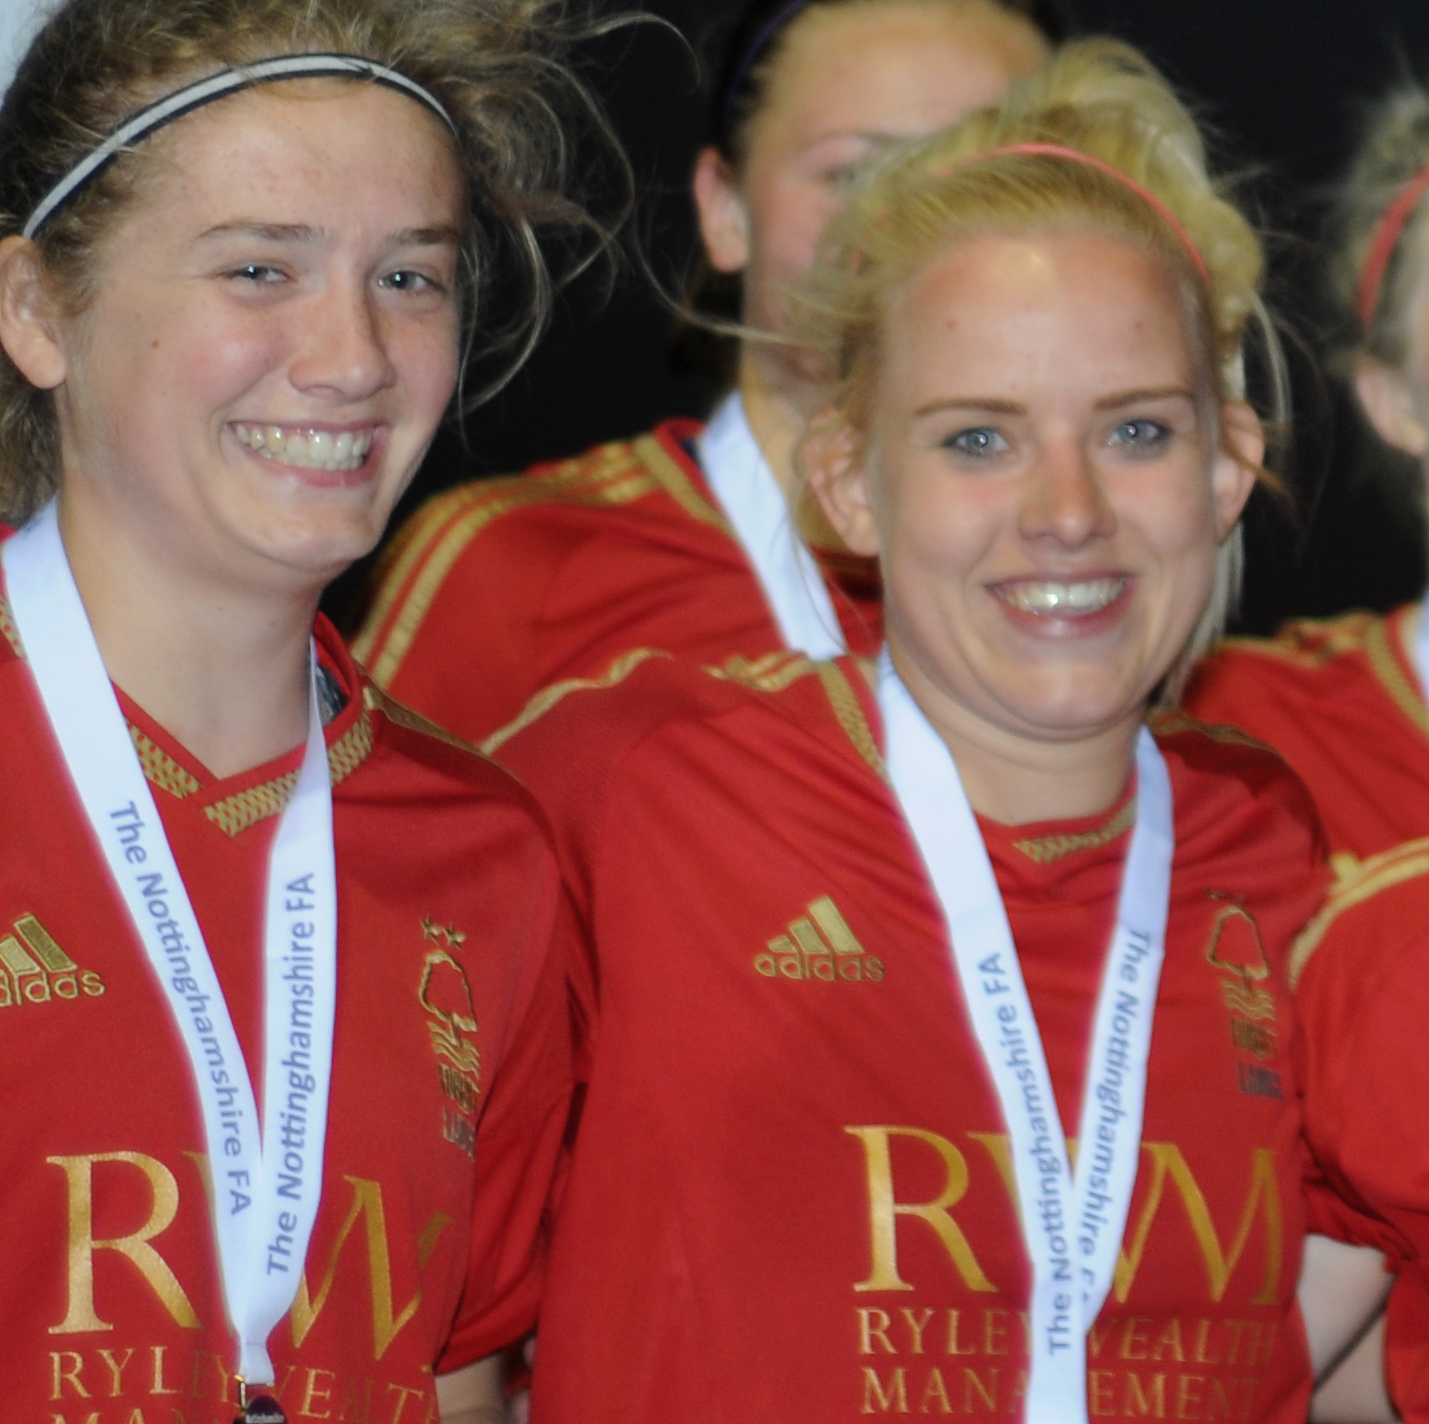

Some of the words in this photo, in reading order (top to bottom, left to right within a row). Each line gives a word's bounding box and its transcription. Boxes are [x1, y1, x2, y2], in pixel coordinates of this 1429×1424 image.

[285, 872, 316, 913] FA
[754, 953, 885, 982] adidas
[977, 951, 1001, 996] FA
[1131, 928, 1153, 983] The
[0, 967, 106, 1008] didas
[109, 800, 148, 866] The
[136, 872, 243, 1158] Nottinghamshire
[228, 1168, 253, 1217] FA
[276, 920, 317, 1200] Nottinghamshire
[998, 1001, 1073, 1282] Nottinghamshire
[1078, 991, 1141, 1258] Nottinghamshire
[45, 1149, 456, 1363] RM
[266, 1211, 299, 1276] The
[857, 1307, 1033, 1356] RYLE
[1047, 1289, 1072, 1356] The
[860, 1366, 1260, 1422] MANEMENT
